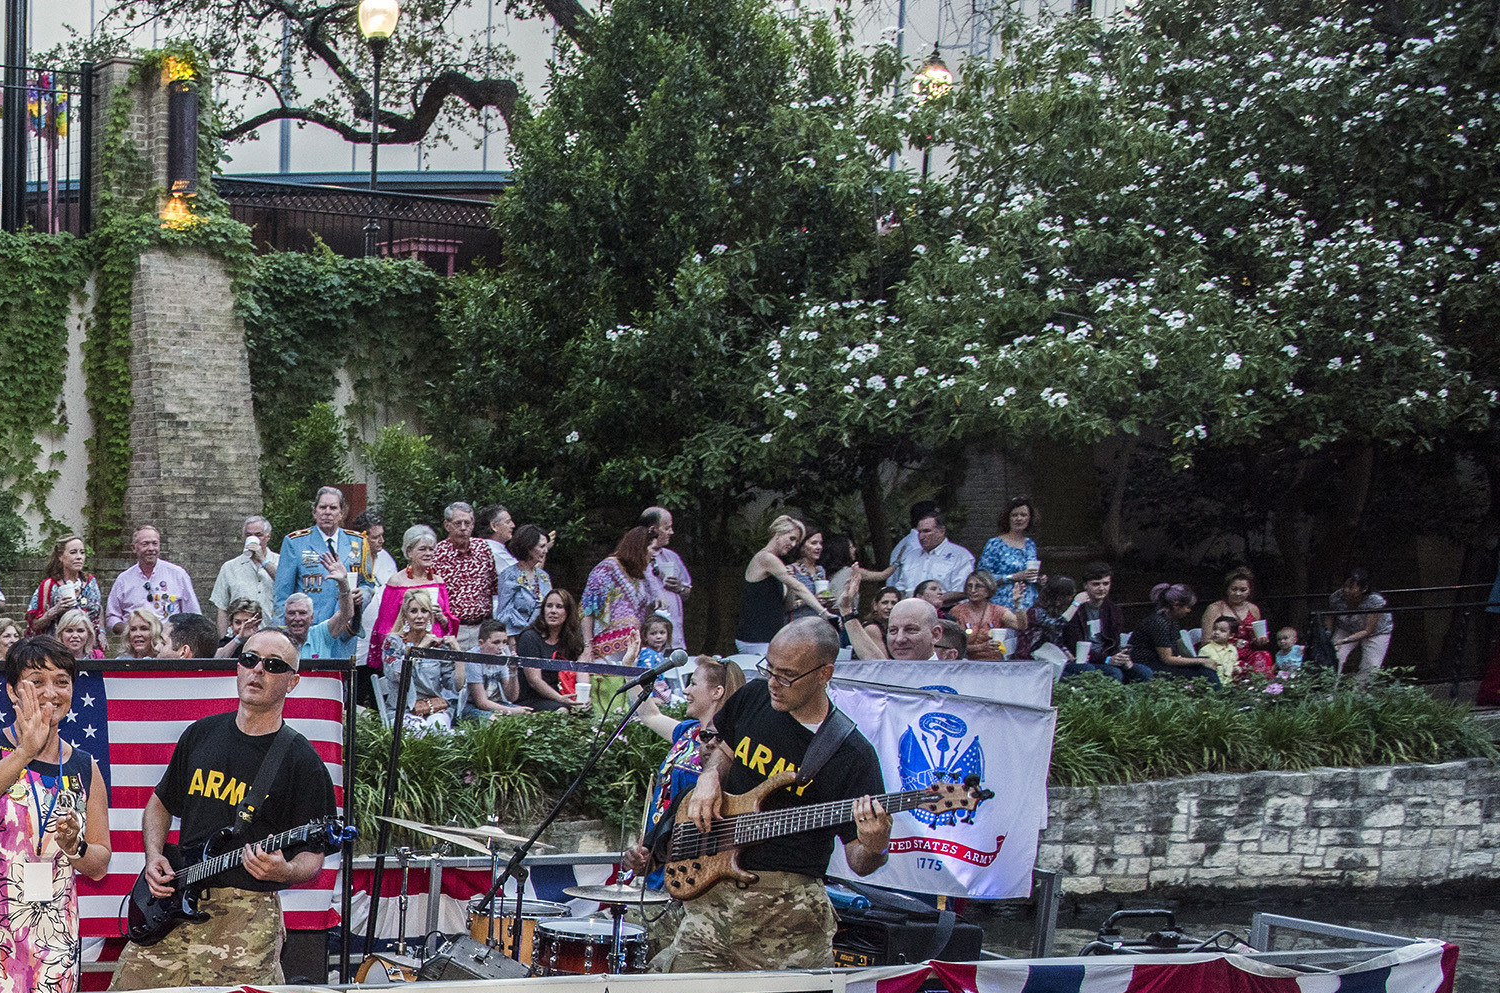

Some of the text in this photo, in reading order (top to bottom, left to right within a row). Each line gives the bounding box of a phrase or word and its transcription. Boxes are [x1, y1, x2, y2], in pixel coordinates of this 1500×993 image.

[188, 768, 269, 812] ARM
[913, 839, 959, 855] STATES
[963, 850, 995, 865] ARMY
[916, 857, 943, 872] 1775
